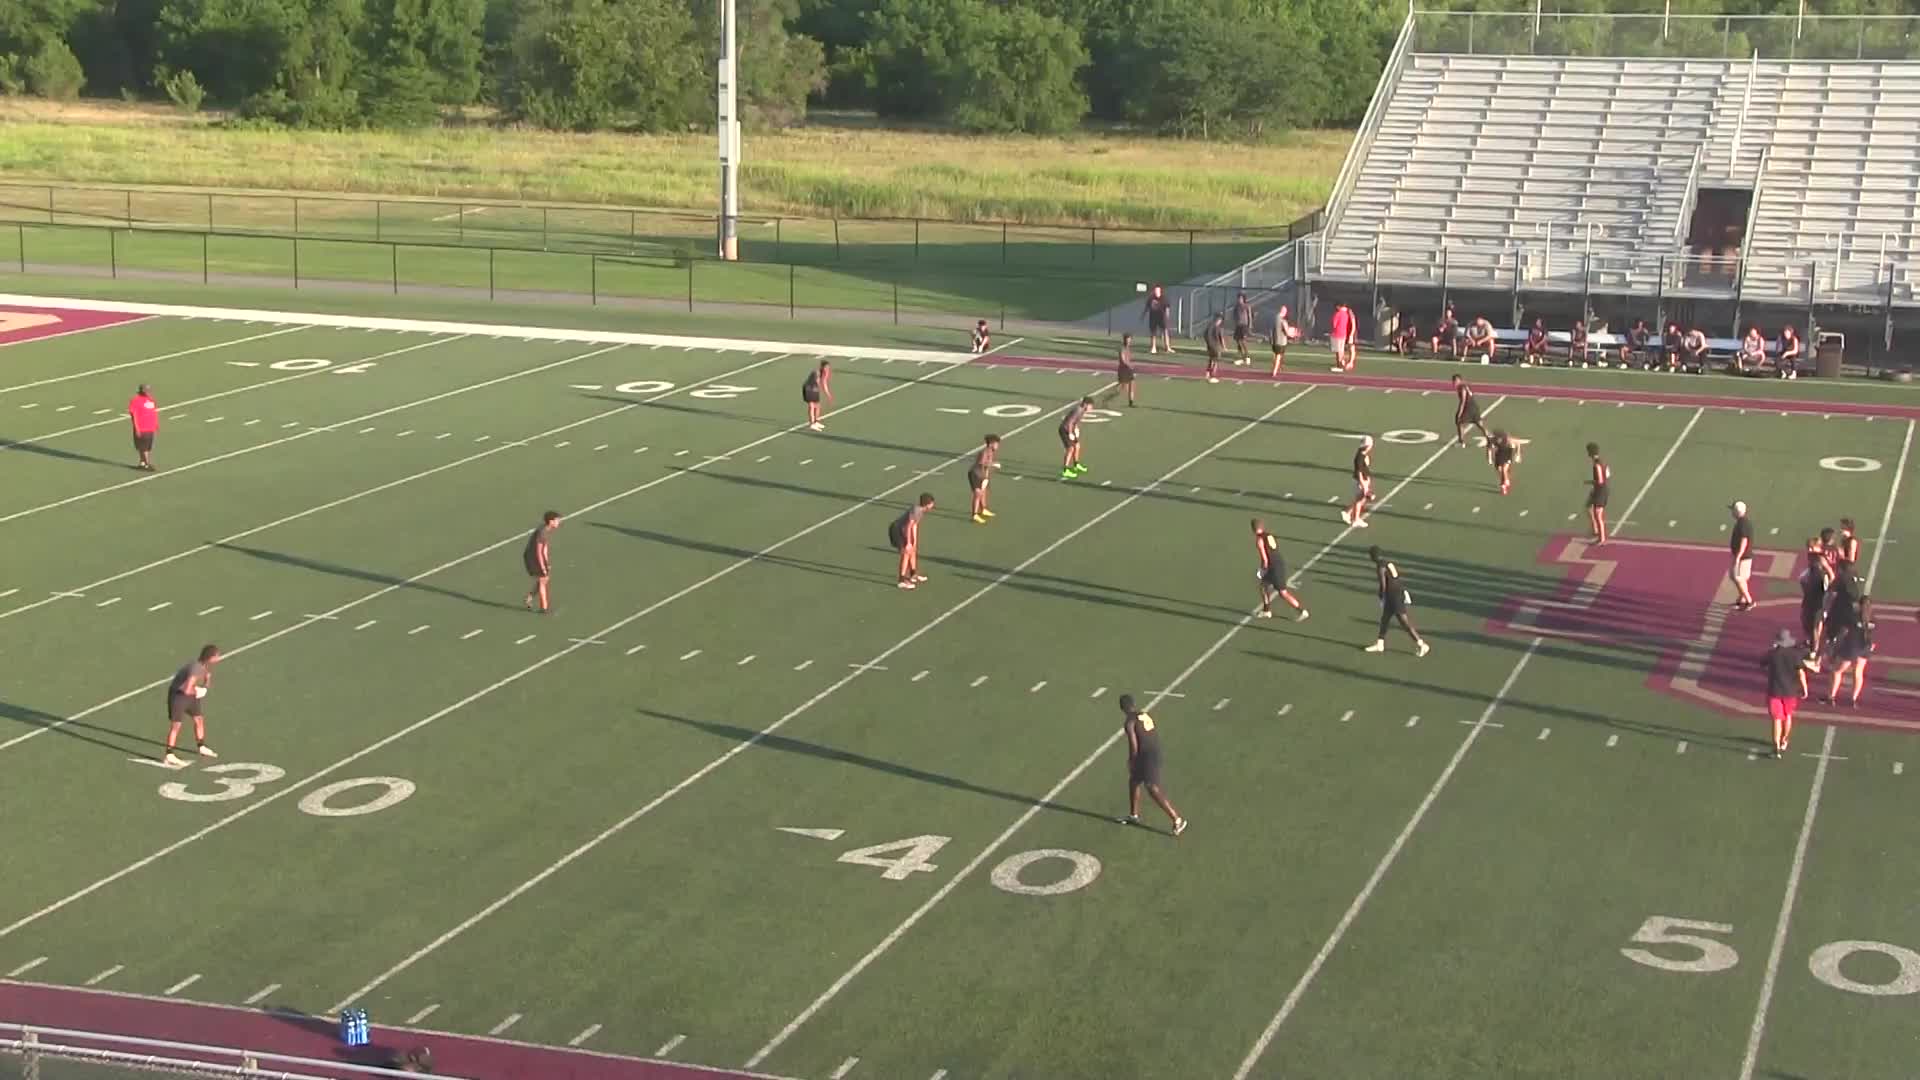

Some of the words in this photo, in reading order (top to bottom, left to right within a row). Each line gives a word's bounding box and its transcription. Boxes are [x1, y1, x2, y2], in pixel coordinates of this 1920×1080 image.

[157, 761, 417, 817] 30
[835, 833, 1102, 896] 40
[1620, 914, 1920, 996] 50
